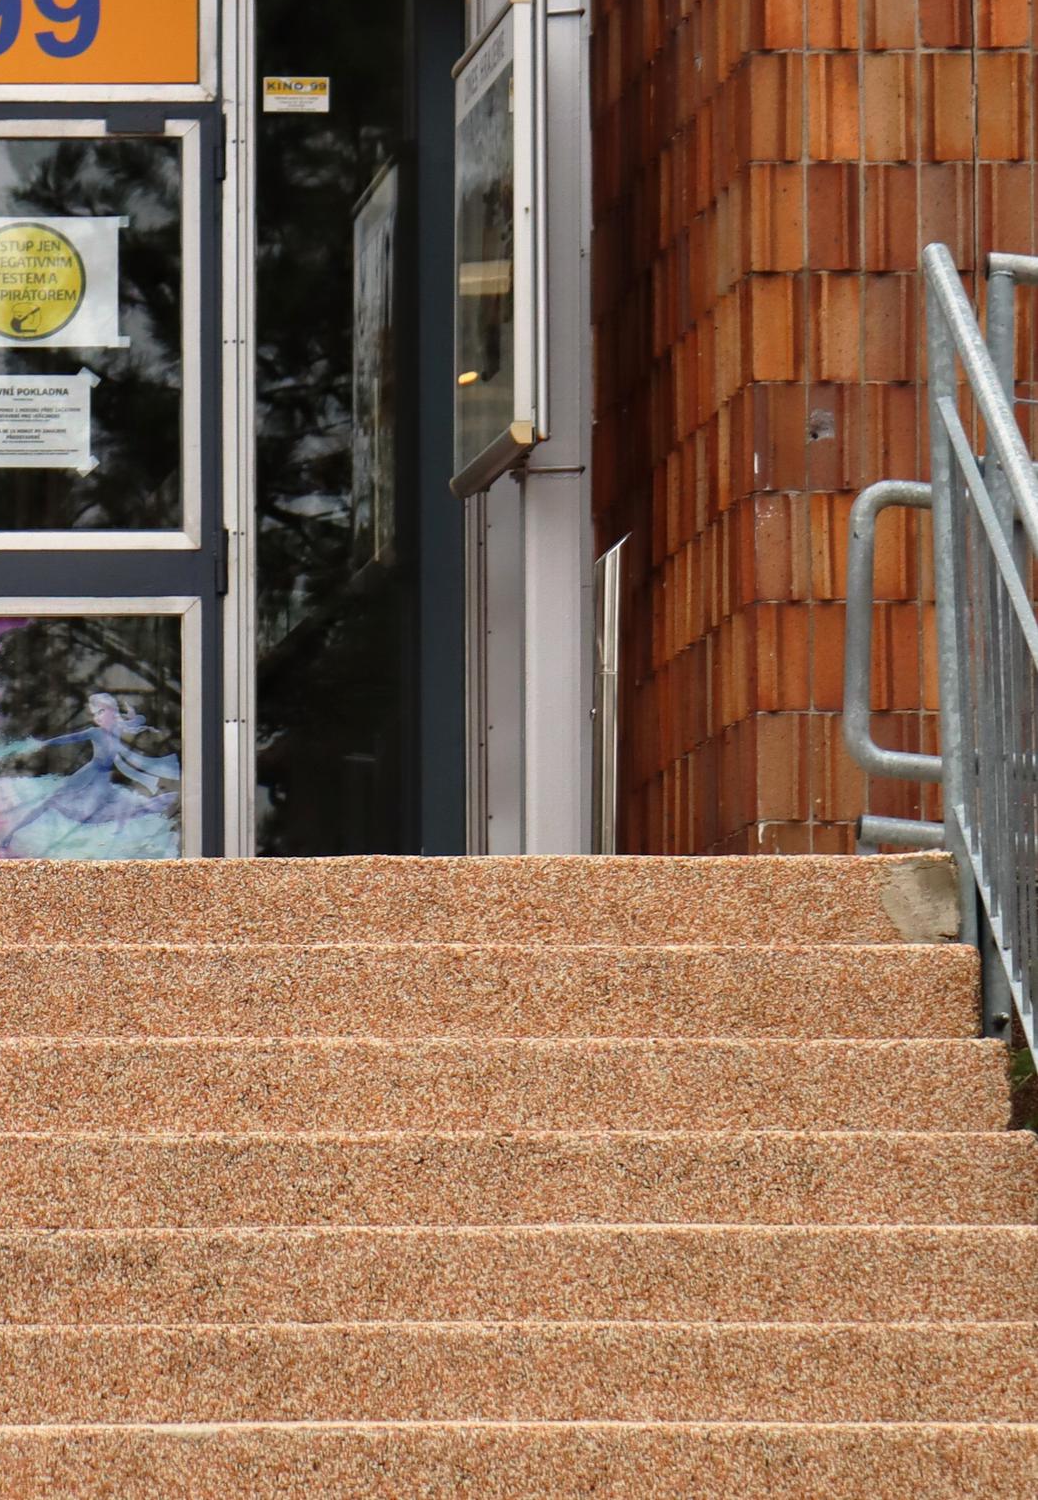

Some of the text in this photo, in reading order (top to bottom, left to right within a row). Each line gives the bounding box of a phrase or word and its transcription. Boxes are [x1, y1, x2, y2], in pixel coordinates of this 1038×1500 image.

[267, 82, 326, 91] KINO 99
[37, 240, 60, 252] JEN
[47, 273, 58, 284] A
[17, 388, 69, 397] POKLADNA
